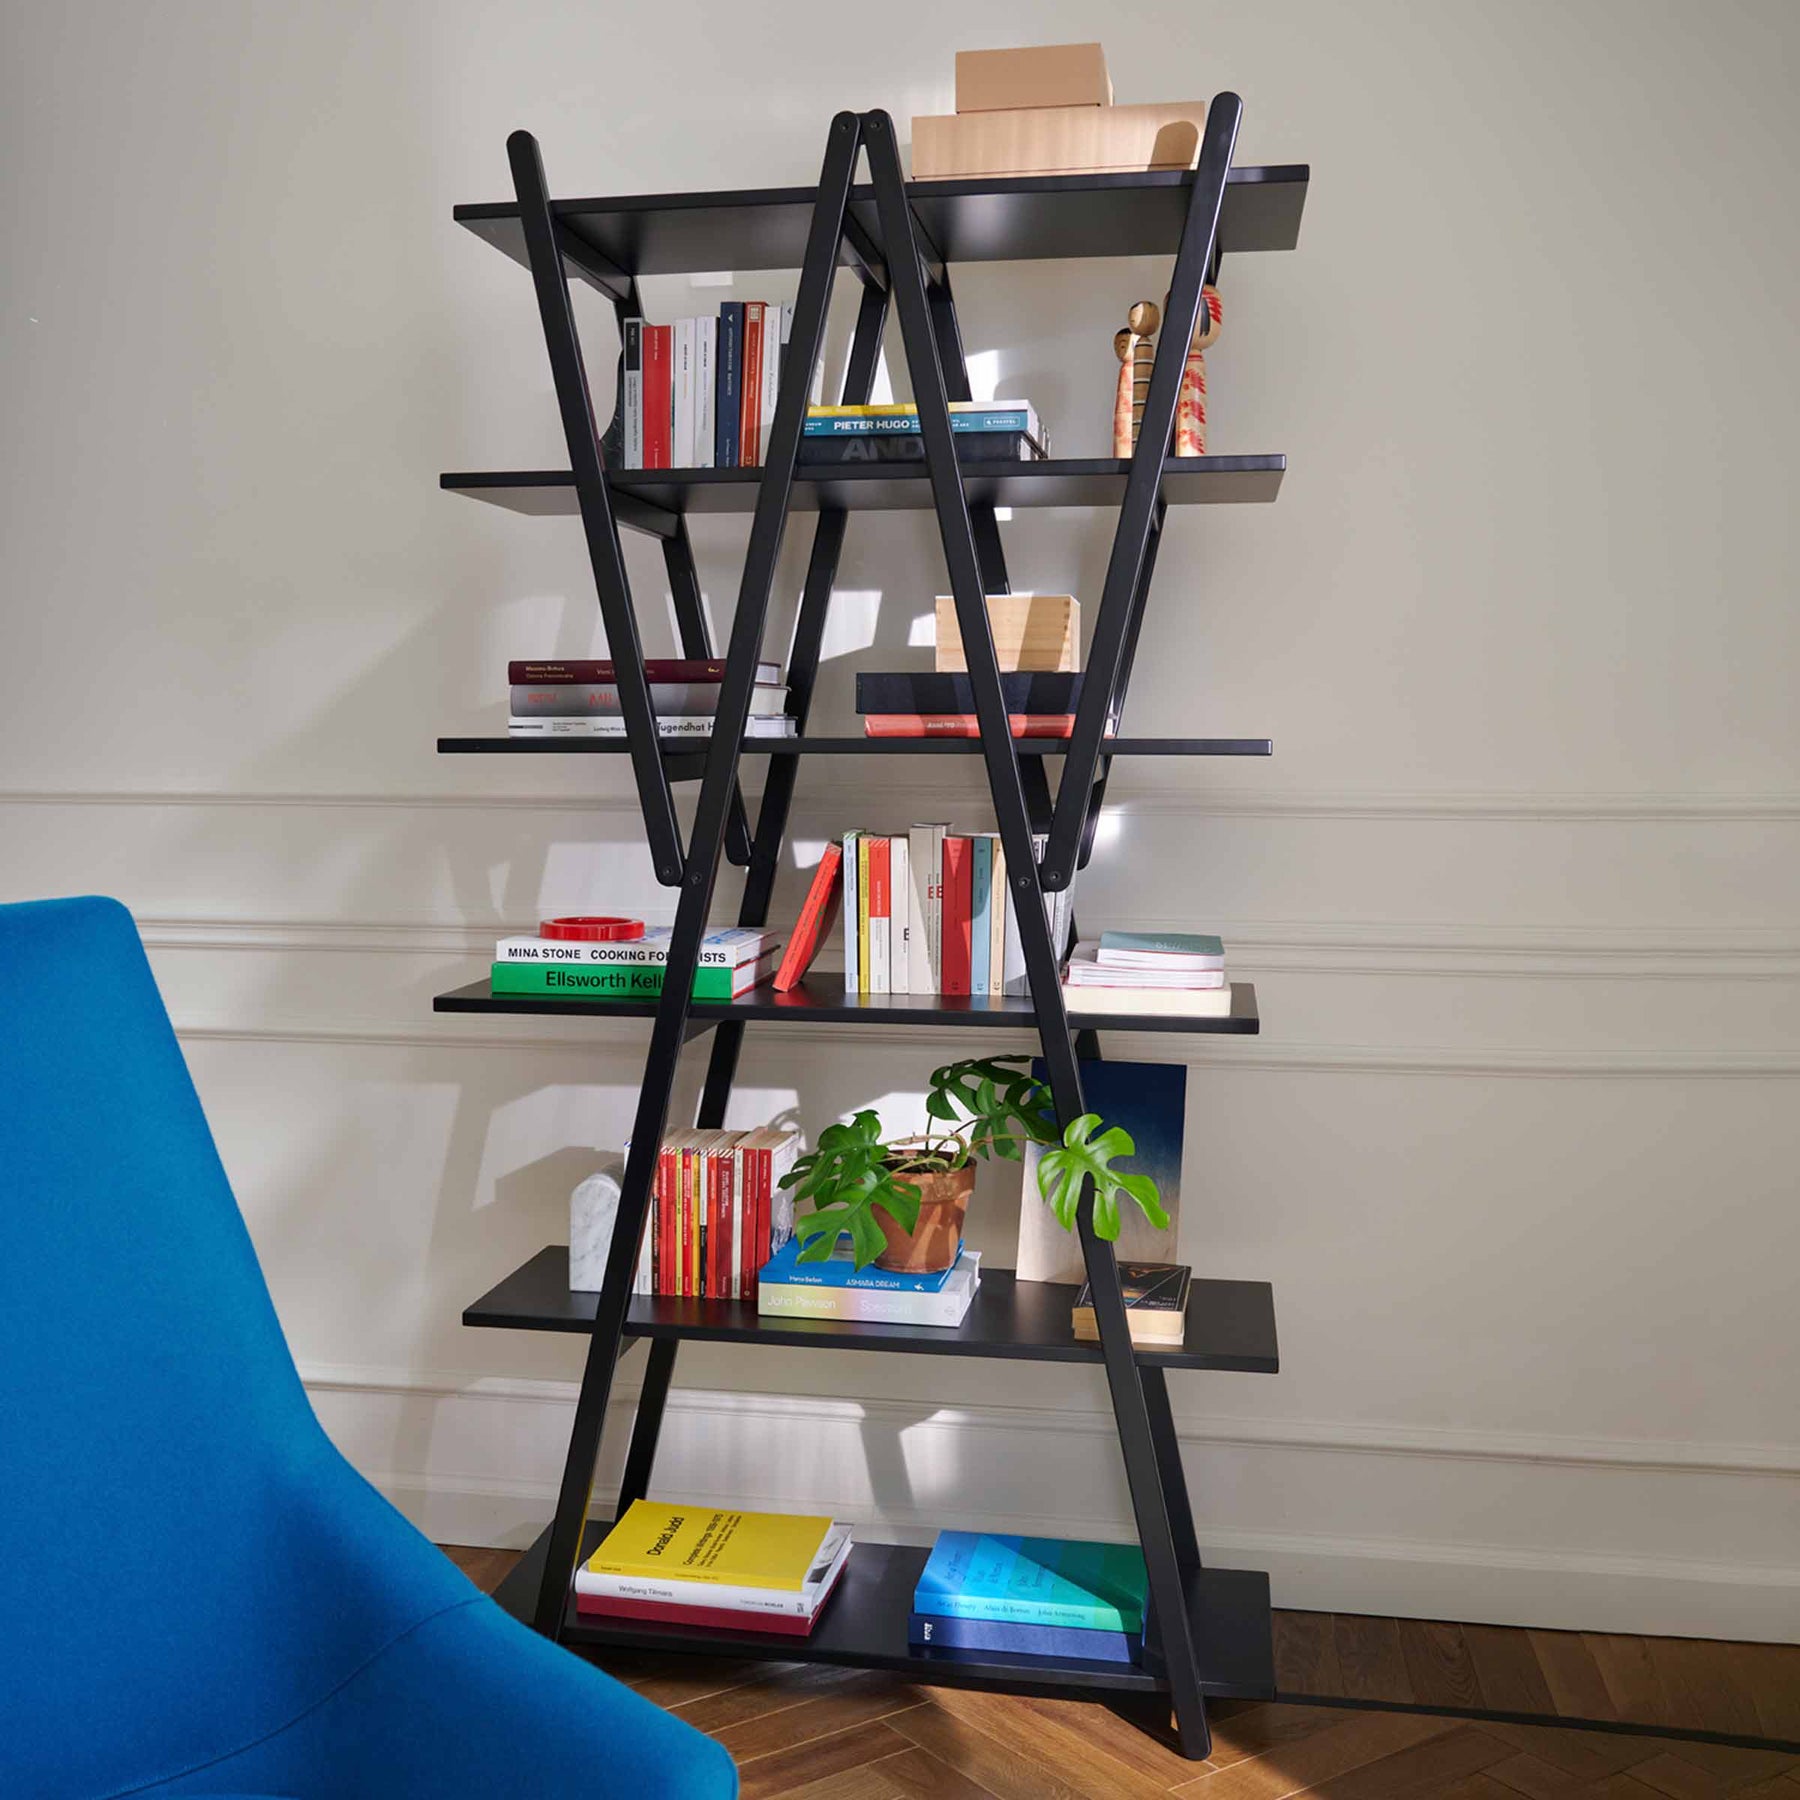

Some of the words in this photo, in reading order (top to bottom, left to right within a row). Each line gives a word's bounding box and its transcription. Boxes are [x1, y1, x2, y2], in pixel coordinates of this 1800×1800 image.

[834, 420, 874, 430] PIETER
[876, 420, 910, 429] HUGO
[508, 948, 539, 957] MINA
[542, 948, 582, 959] STONE
[591, 949, 646, 961] COOKING
[546, 971, 627, 988] Ellsworth
[631, 973, 664, 989] Kell
[875, 1280, 900, 1289] DREAM
[646, 1533, 674, 1556] Donald
[664, 1516, 685, 1534] Judd
[619, 1585, 647, 1595] Wolfgang
